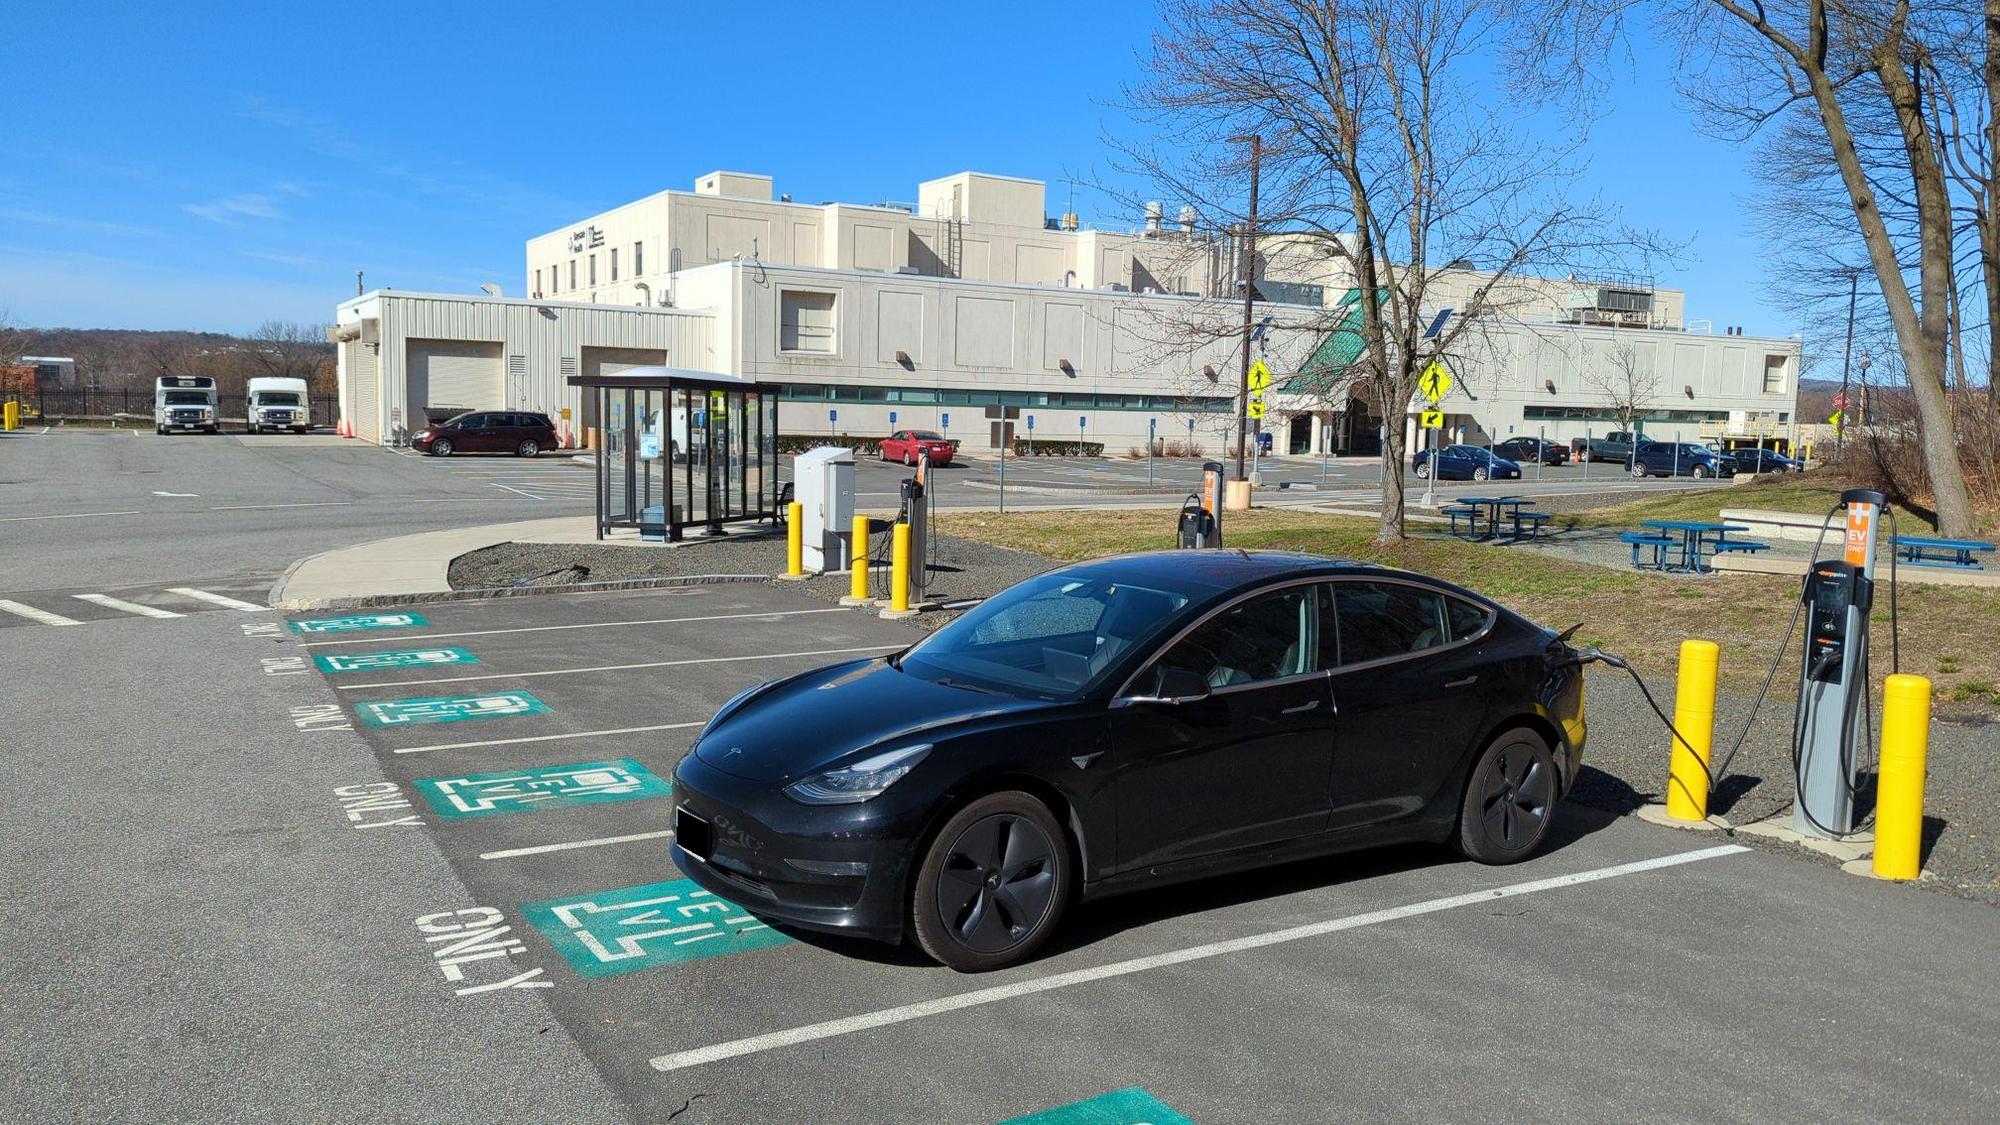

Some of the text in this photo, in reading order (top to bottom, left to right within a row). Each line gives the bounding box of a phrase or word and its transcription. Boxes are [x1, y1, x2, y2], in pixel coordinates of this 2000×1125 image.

[1847, 544, 1865, 553] ONLY
[1848, 529, 1867, 542] EV
[289, 704, 355, 732] ONLY
[333, 781, 426, 829] ONLY
[415, 906, 554, 996] ONLY
